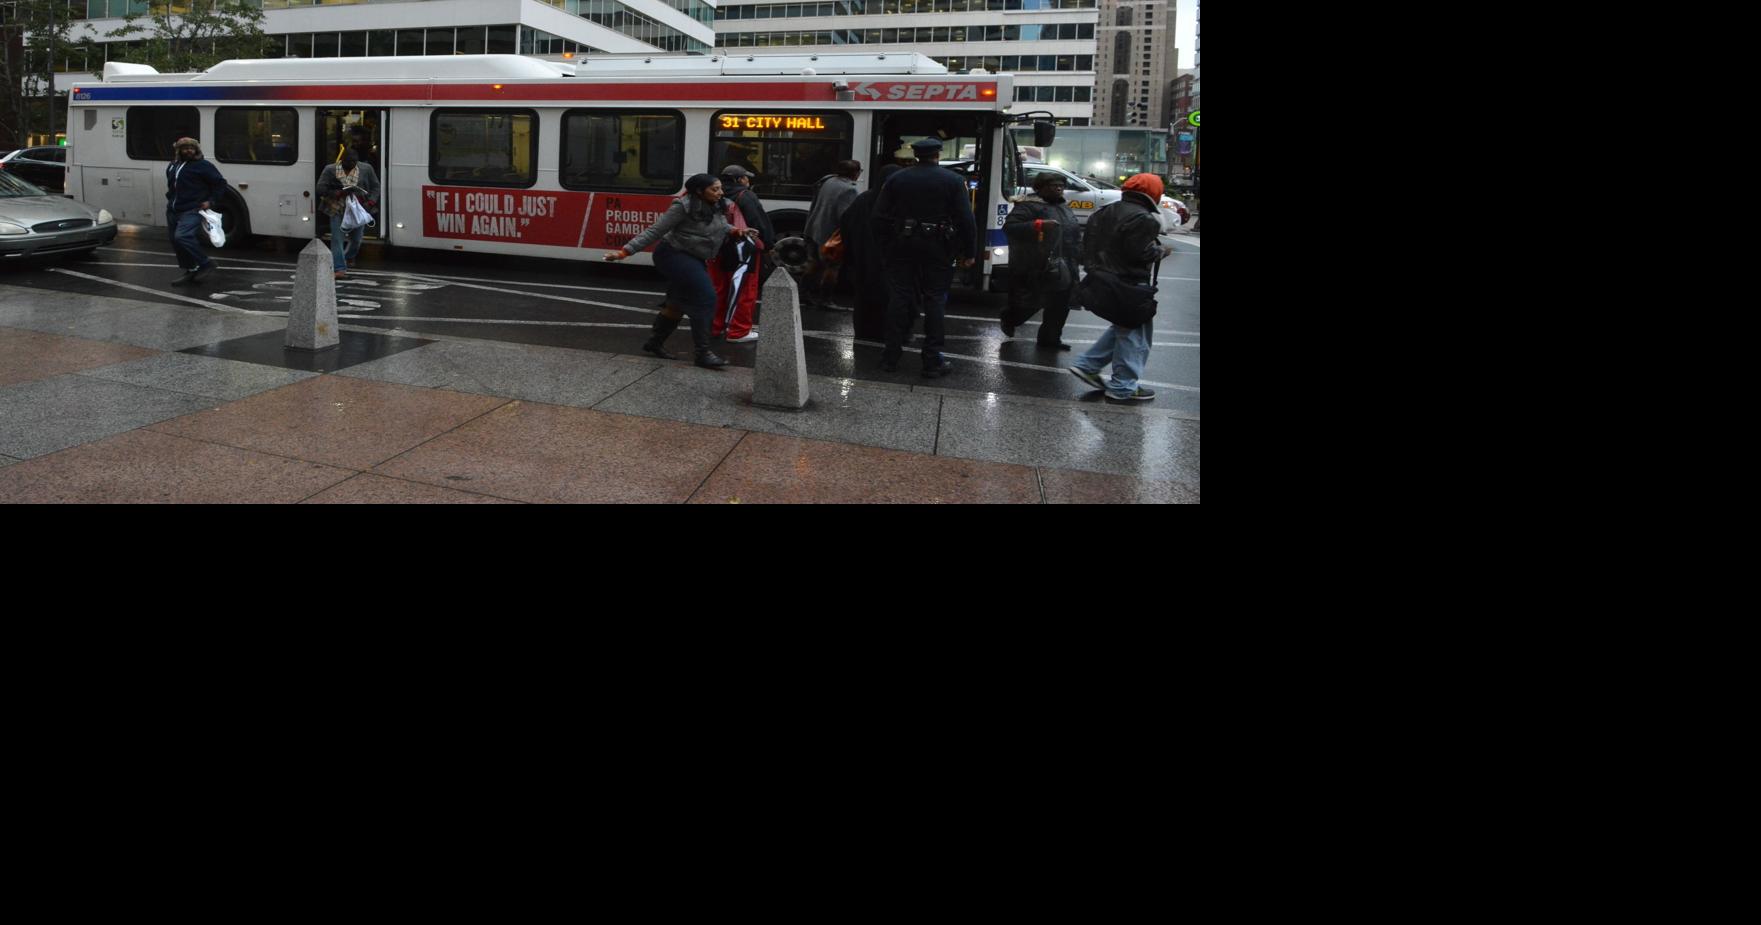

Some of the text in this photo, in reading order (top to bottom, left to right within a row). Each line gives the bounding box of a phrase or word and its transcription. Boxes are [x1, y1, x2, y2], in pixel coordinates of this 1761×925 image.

[887, 84, 977, 100] SEPTA
[722, 116, 825, 129] 31 CITY HALL
[454, 192, 460, 212] I
[465, 192, 514, 215] COULD
[518, 195, 558, 218] JUST
[606, 197, 622, 209] PA
[1069, 200, 1094, 209] AB
[436, 212, 530, 238] WIN AGAIN."
